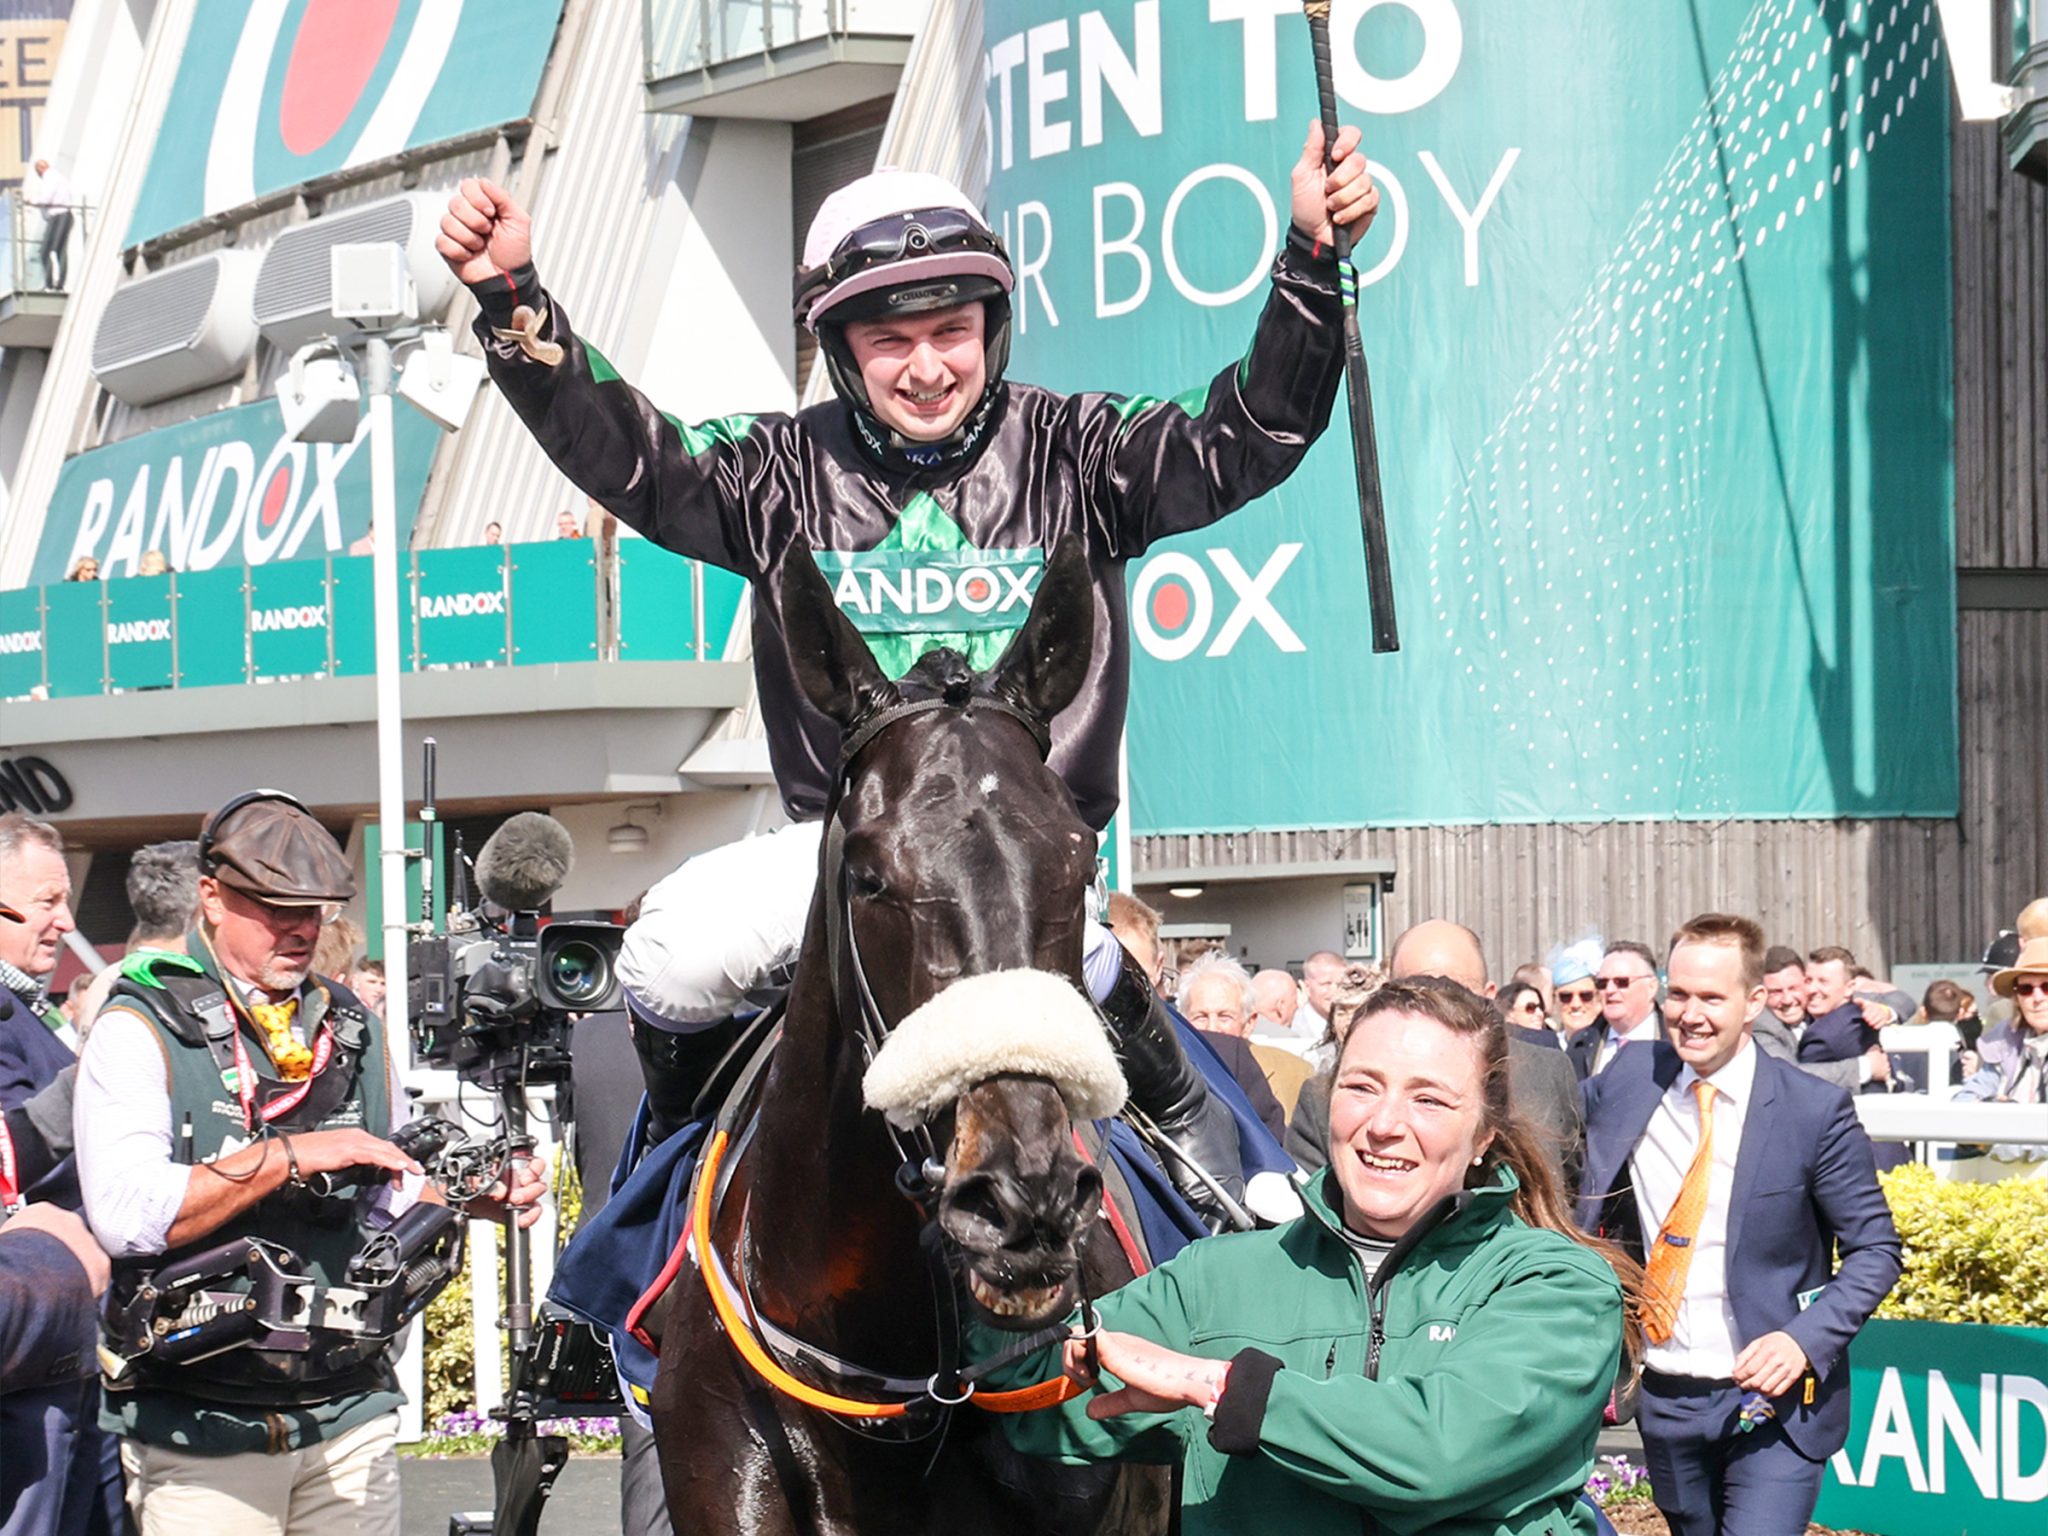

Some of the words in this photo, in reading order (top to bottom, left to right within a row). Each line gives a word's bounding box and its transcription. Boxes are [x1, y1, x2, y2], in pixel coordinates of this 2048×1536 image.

[1209, 0, 1463, 122] TO
[65, 411, 371, 580] RANDOX
[419, 591, 504, 618] RANDOX
[834, 565, 1042, 615] ANDOX
[107, 619, 171, 645] RANDOX
[251, 605, 326, 632] RANDOX
[0, 756, 74, 816] ND
[1429, 1325, 1456, 1342] RA
